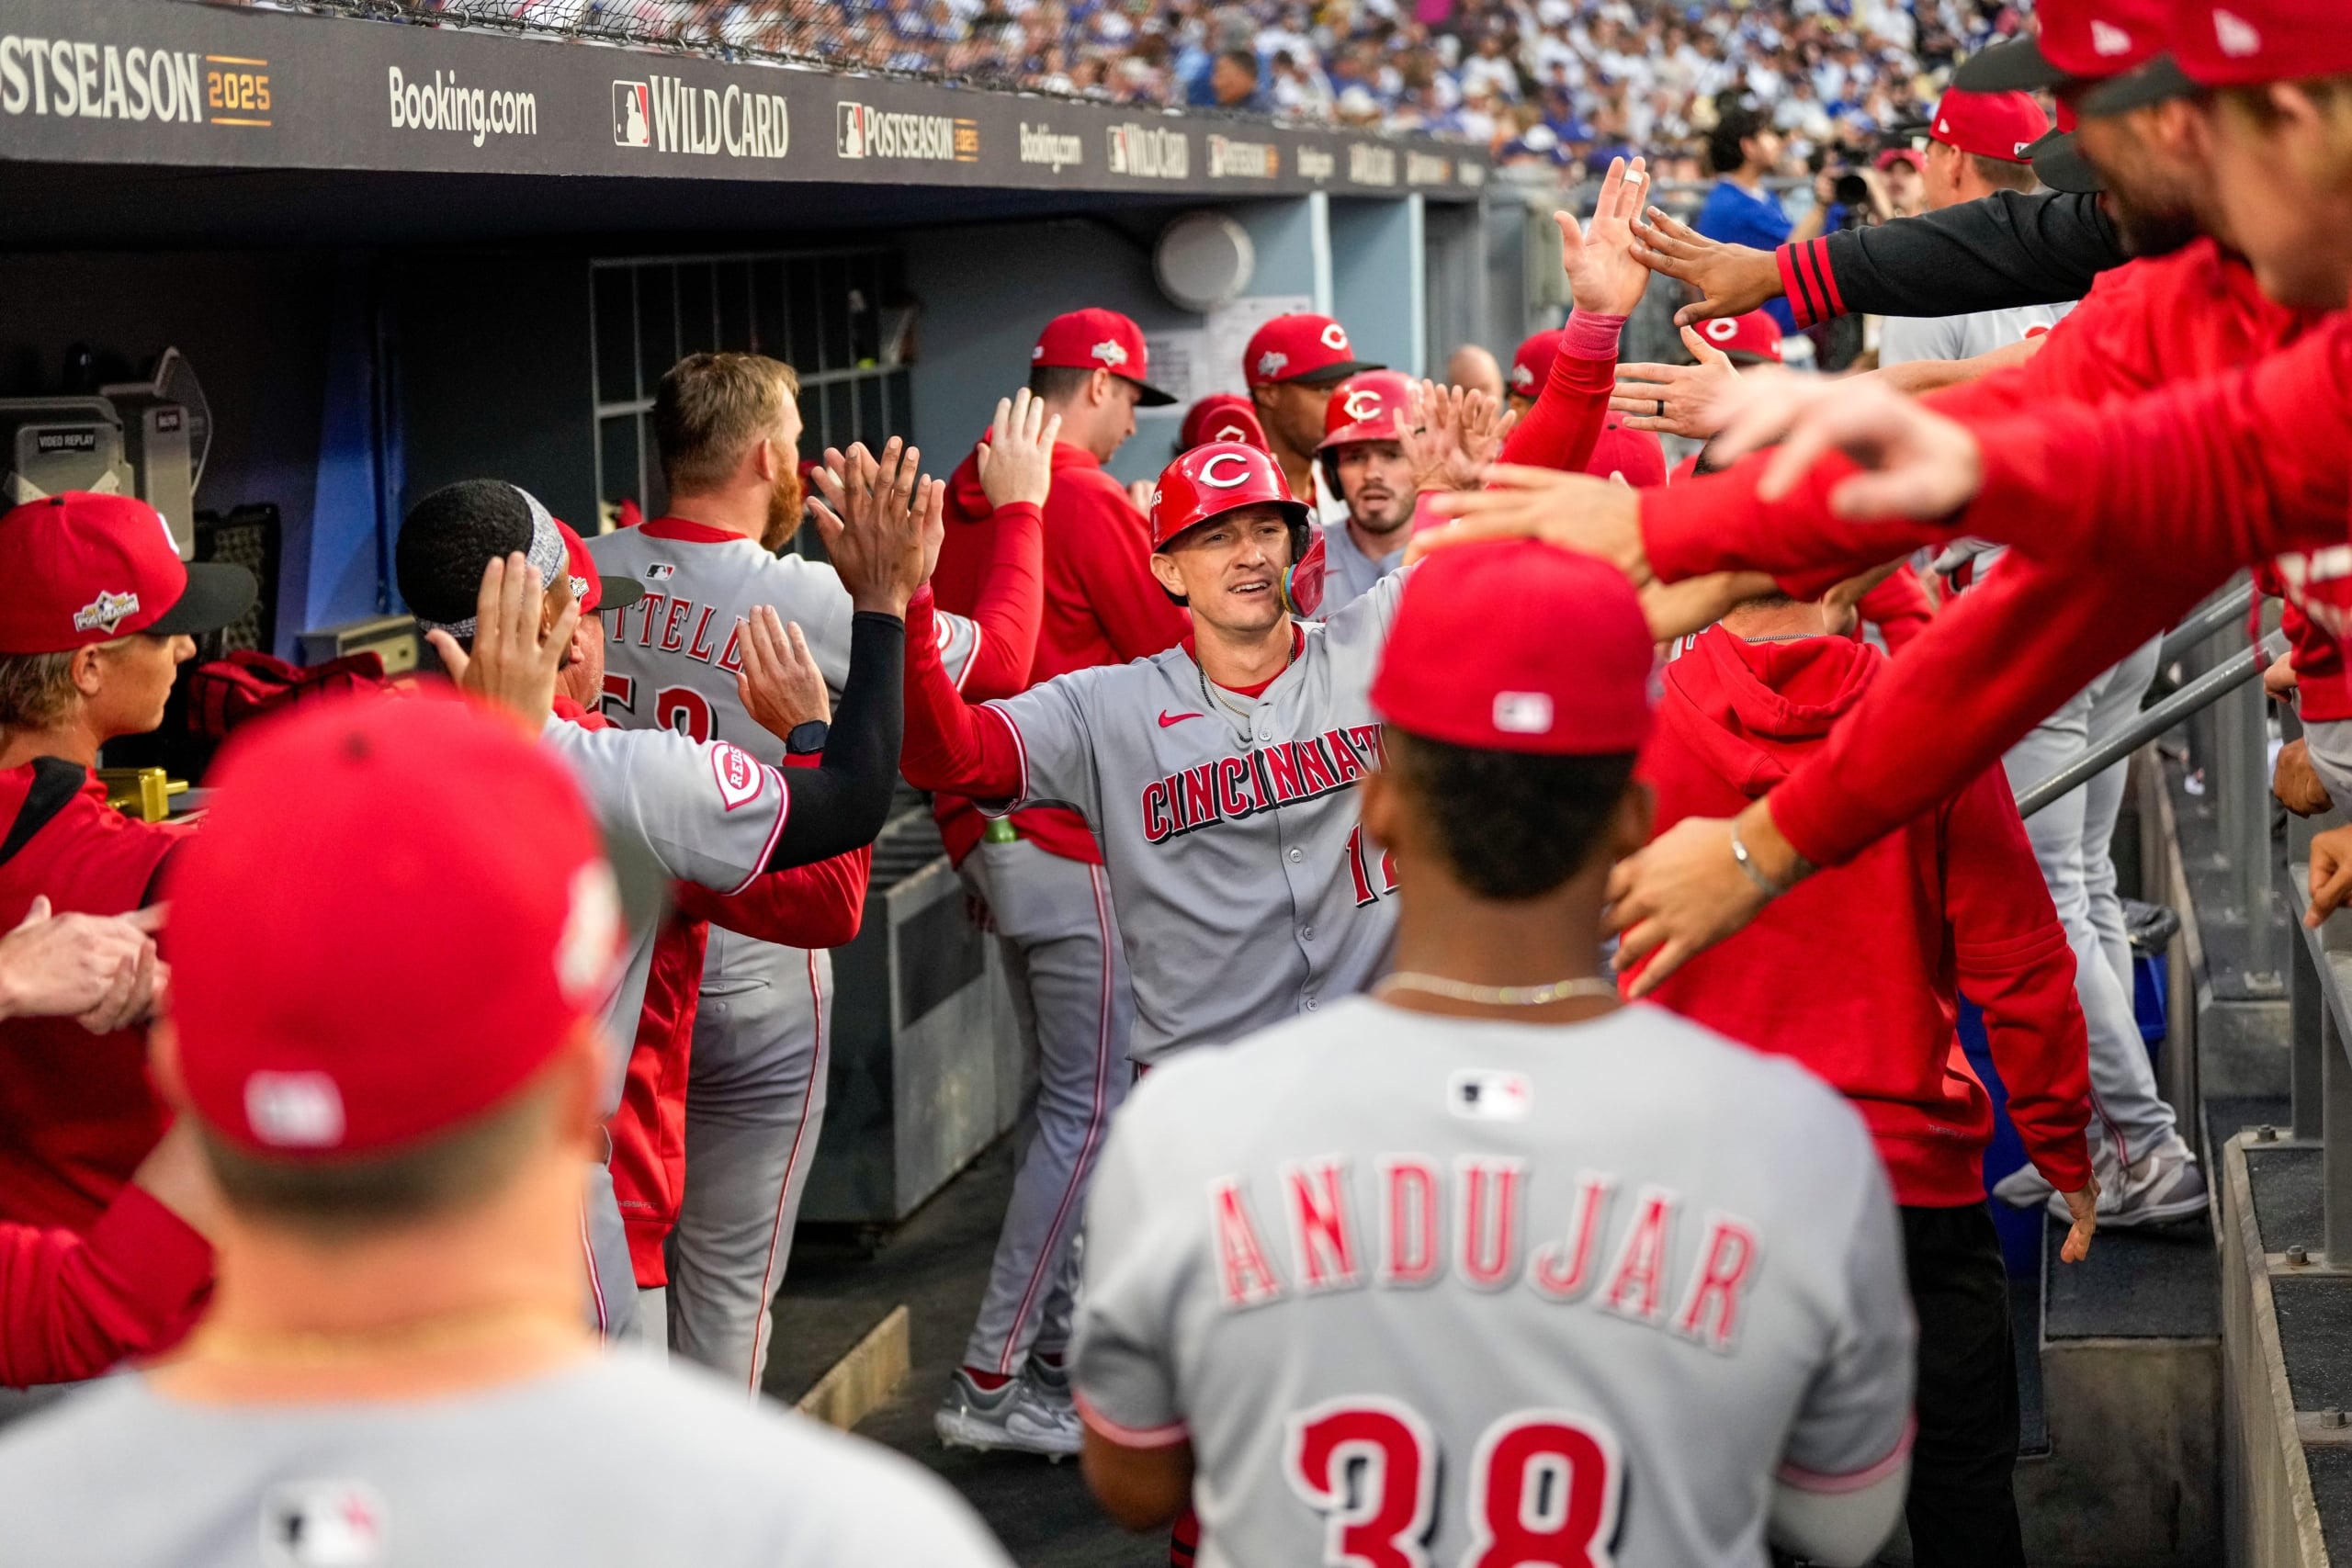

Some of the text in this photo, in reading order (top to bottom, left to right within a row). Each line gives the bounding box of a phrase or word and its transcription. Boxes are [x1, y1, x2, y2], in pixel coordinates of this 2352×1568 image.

[208, 72, 270, 111] 2025
[389, 65, 537, 148] Booking.com
[864, 106, 954, 161] POSTSEASON
[39, 434, 94, 448] VIDEO REPLAY
[1198, 453, 1250, 490] C
[597, 592, 748, 674] TTELL
[729, 746, 744, 788] REDS
[1210, 1152, 1762, 1355] ANDUJAR
[1287, 1395, 1626, 1568] 38
